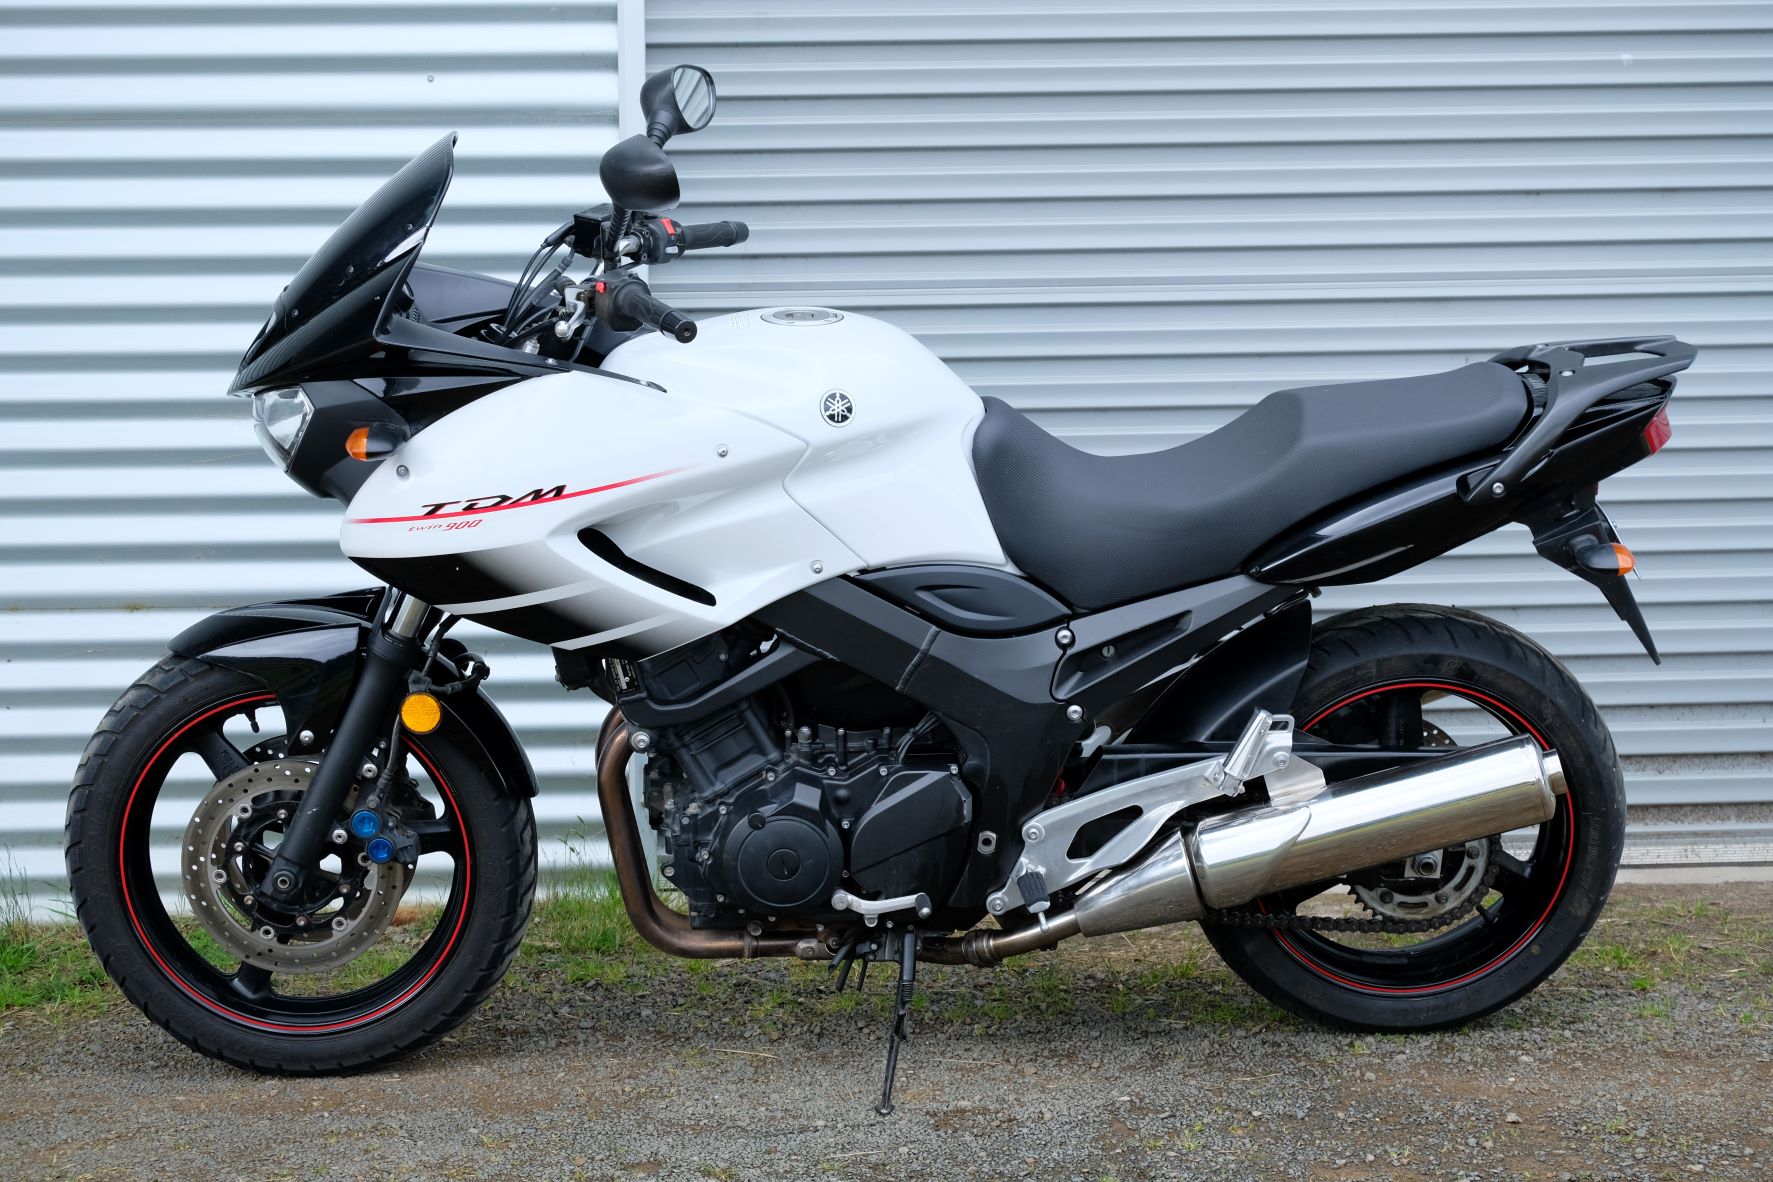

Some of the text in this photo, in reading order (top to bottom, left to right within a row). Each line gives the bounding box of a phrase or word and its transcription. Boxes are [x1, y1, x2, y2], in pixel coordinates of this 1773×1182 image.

[421, 484, 567, 517] TDM
[408, 519, 483, 532] twin 900
